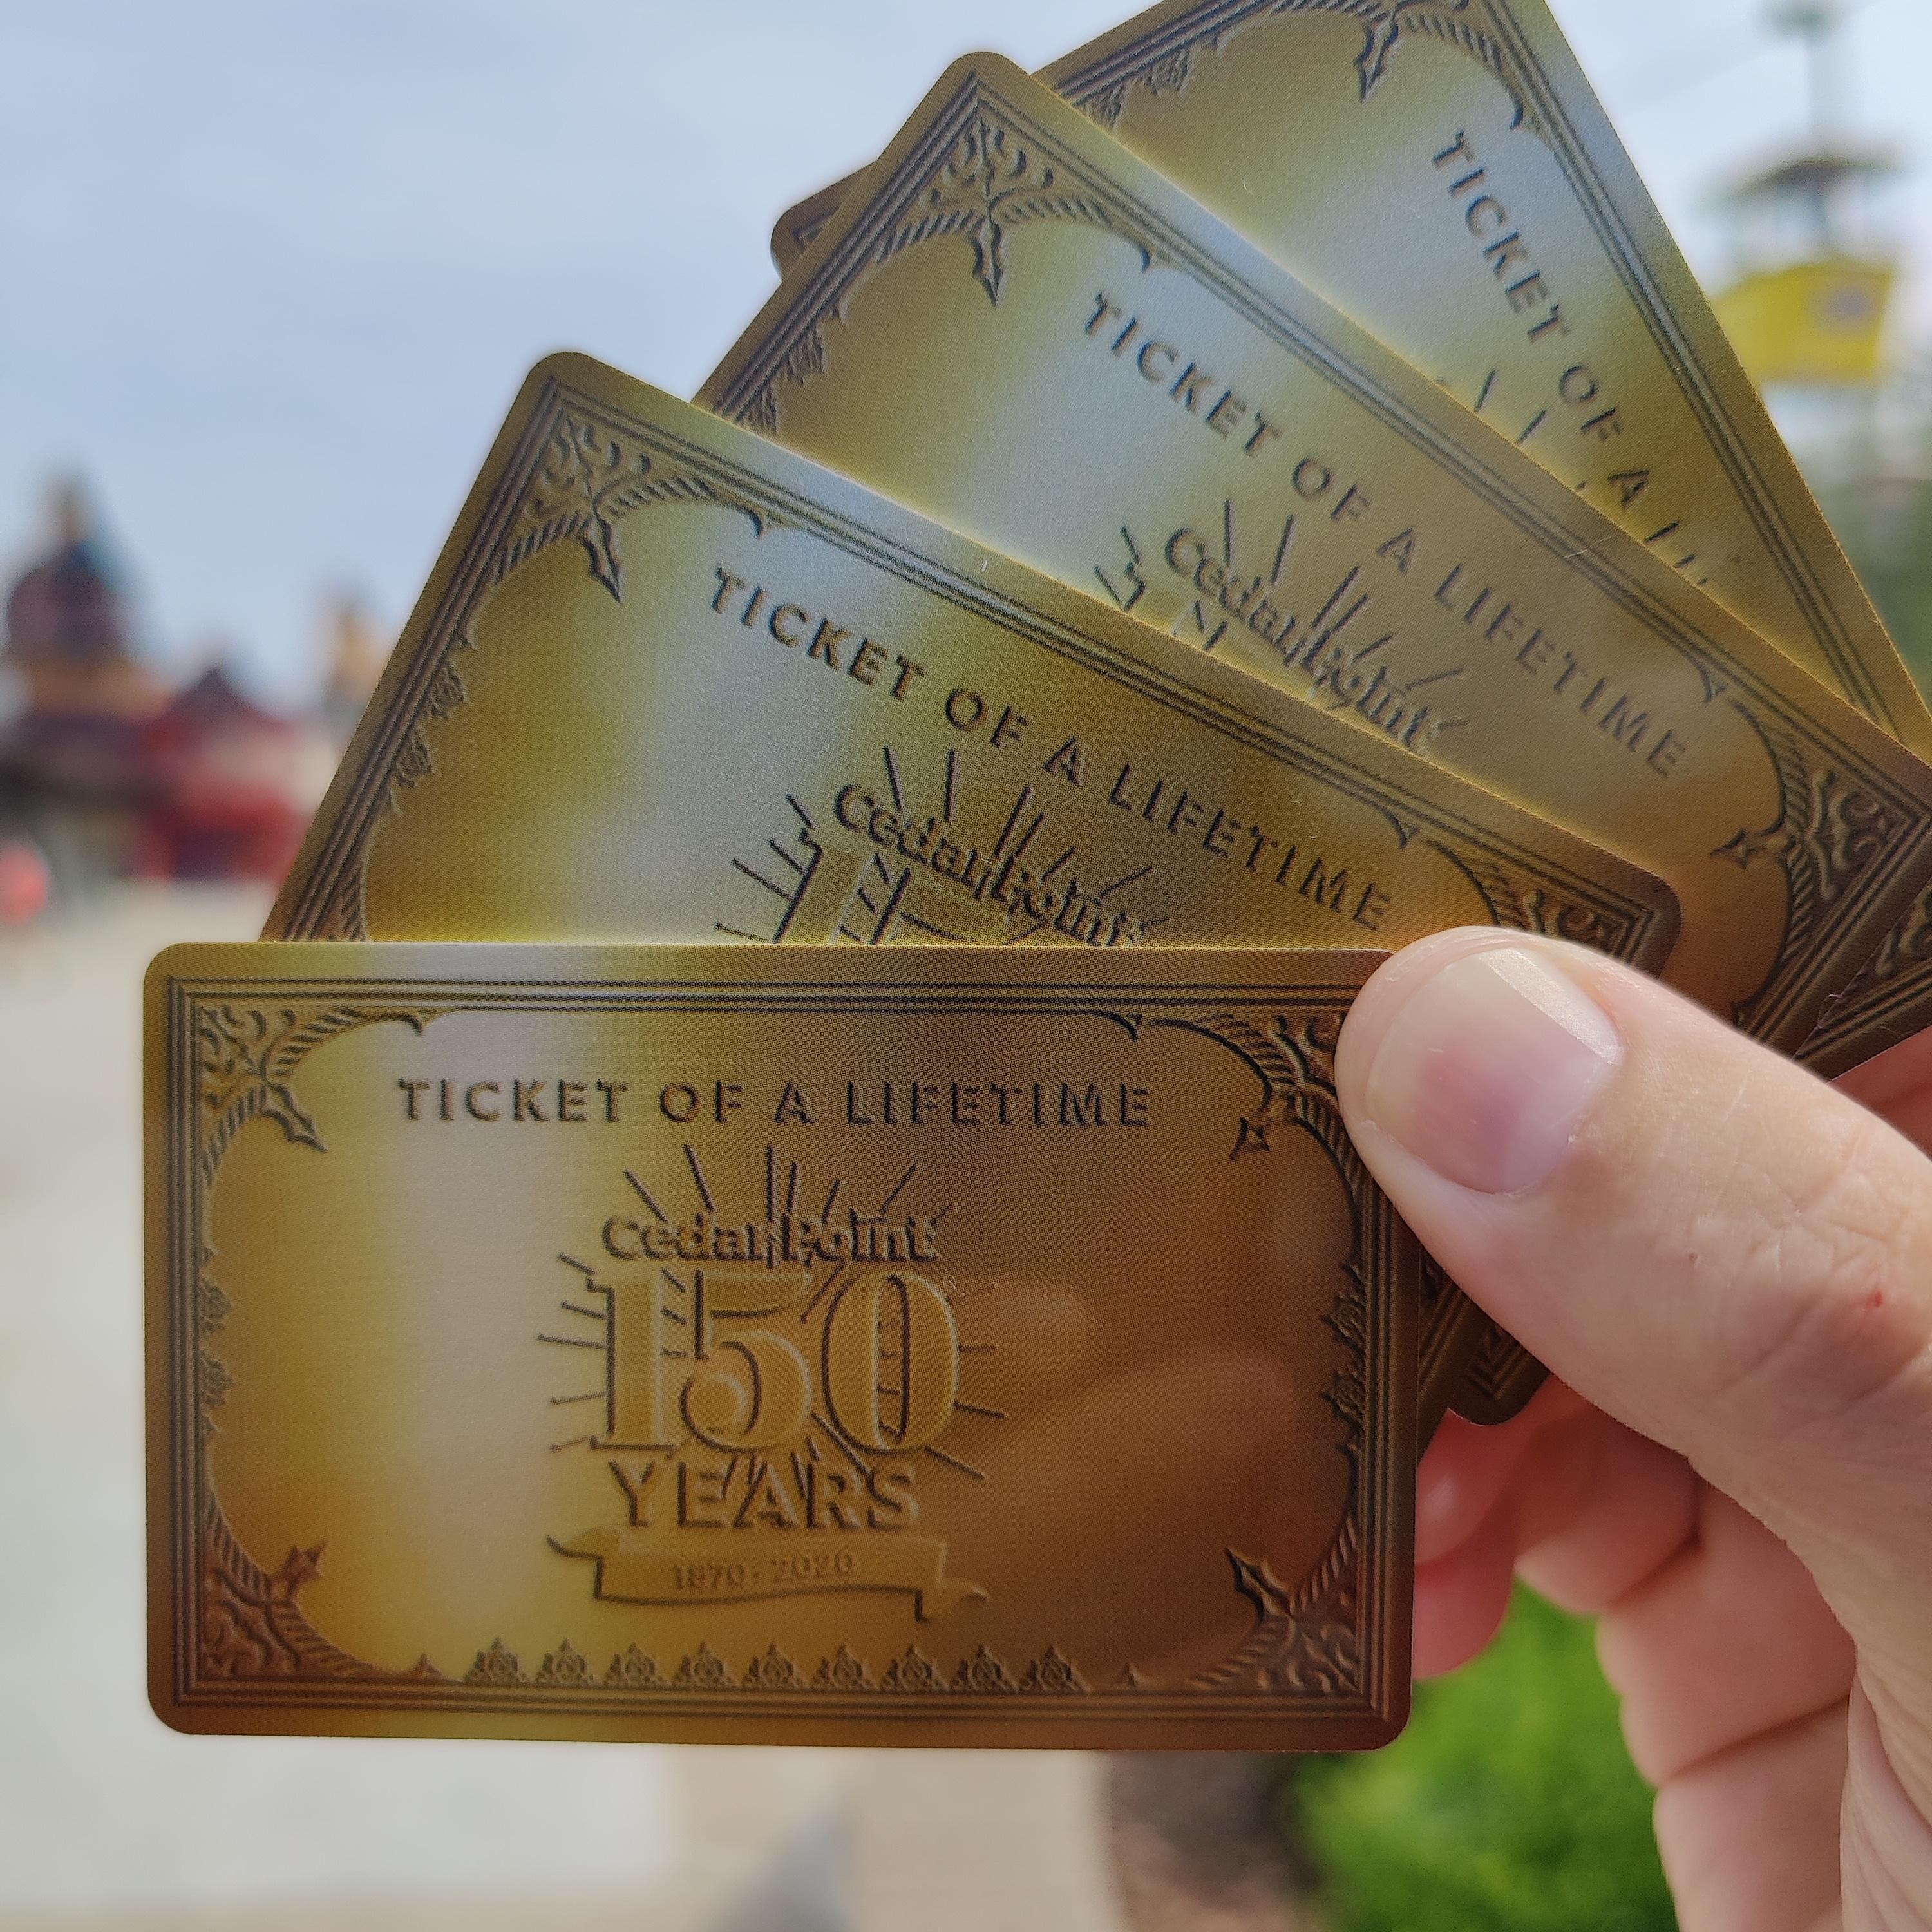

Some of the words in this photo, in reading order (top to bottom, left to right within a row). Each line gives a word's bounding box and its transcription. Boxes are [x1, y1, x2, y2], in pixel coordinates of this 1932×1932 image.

[1432, 130, 1567, 344] TICKET
[1557, 365, 1622, 443] OF
[1607, 468, 1651, 513] A
[1083, 291, 1282, 458] TICKET
[1291, 457, 1370, 522] OF
[1374, 527, 1415, 575] A
[1434, 562, 1688, 778] LIFETIME
[1164, 527, 1302, 654] Cedar
[711, 566, 926, 703] TICKET
[943, 686, 1030, 748] OF
[1041, 736, 1088, 787] A
[1108, 762, 1393, 933] LIFETIME
[835, 782, 984, 890] Cedar
[397, 1077, 629, 1124] TICKET
[658, 1079, 745, 1125] OF
[773, 1079, 814, 1125] A
[846, 1079, 1153, 1127] LIFETIME
[601, 1213, 766, 1261] Cedar
[779, 1208, 942, 1262] Point
[589, 1267, 960, 1455] 150
[607, 1458, 919, 1531] YEARS
